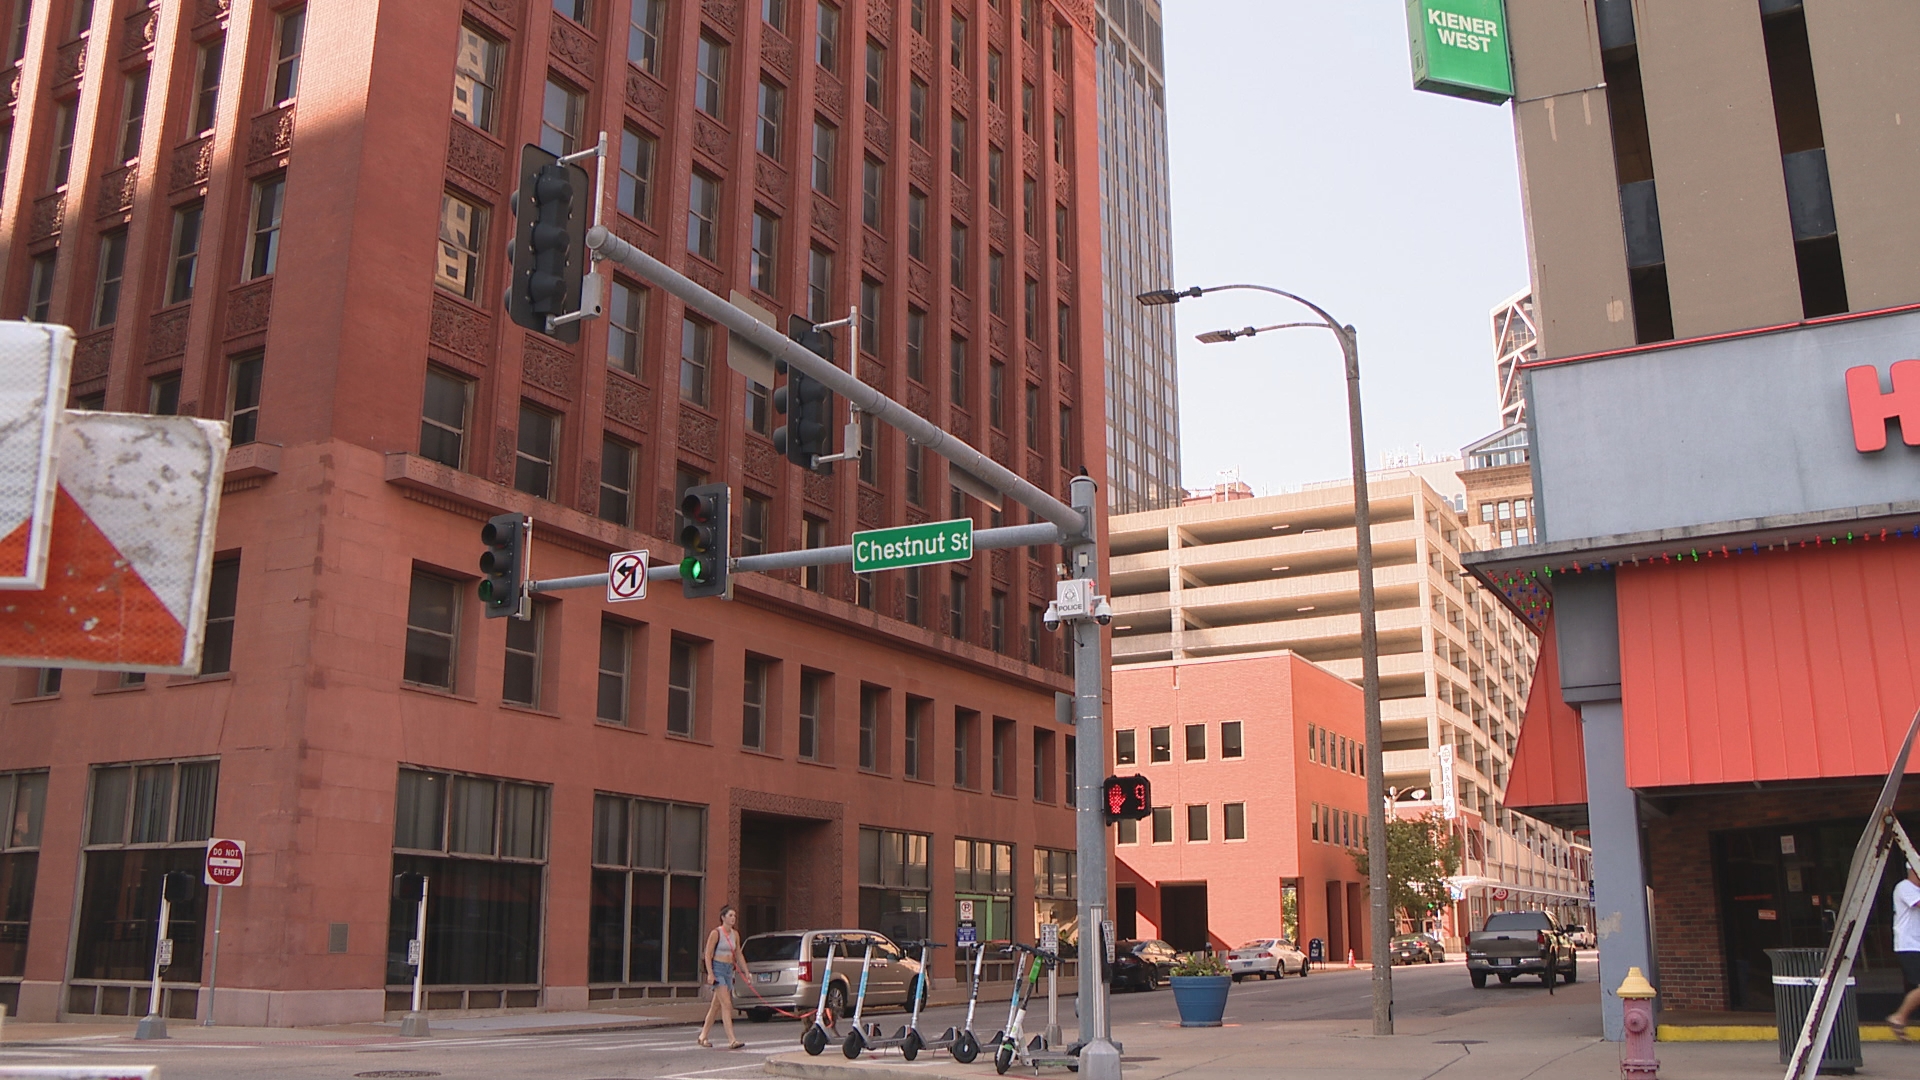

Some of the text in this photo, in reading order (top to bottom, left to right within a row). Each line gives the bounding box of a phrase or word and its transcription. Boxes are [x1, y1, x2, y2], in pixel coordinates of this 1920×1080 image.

[1428, 8, 1498, 37] KIENER
[1437, 28, 1491, 53] WEST
[856, 531, 968, 562] Chestnut St
[1058, 603, 1083, 612] POLICE
[1135, 784, 1145, 810] 9
[212, 848, 239, 857] DO NOT
[213, 868, 235, 877] ENTER
